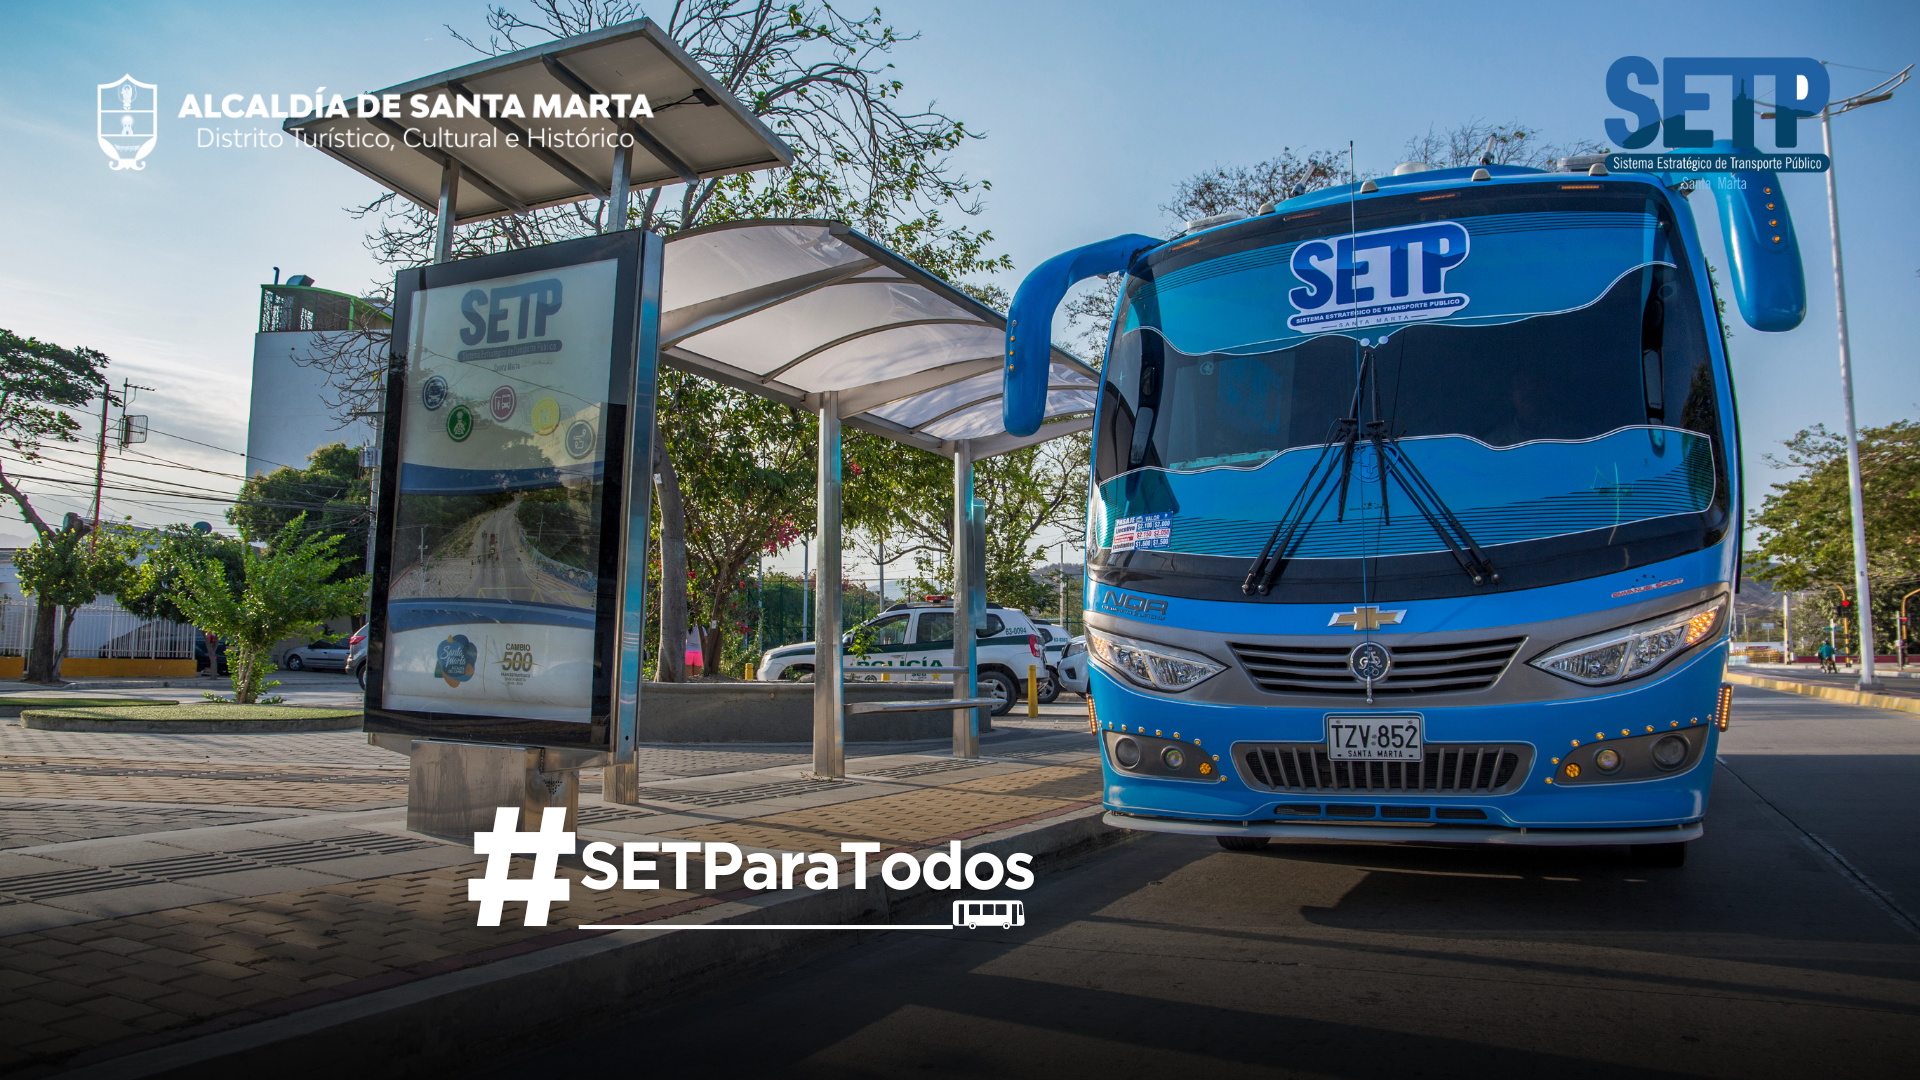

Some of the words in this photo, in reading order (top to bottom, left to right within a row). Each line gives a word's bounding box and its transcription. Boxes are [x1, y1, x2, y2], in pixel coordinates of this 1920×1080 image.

[1290, 223, 1467, 310] SETP
[460, 278, 563, 346] SETP
[1296, 315, 1324, 324] SISTEMA
[1383, 302, 1428, 313] TRANSPORTE
[1429, 298, 1460, 308] PUBLICO
[1338, 319, 1370, 328] SANTA
[1376, 314, 1409, 324] MARTA
[1655, 578, 1683, 589] SPORT
[1103, 591, 1168, 615] NQR
[505, 643, 531, 651] CAMBIO
[501, 651, 533, 672] 500
[1331, 724, 1370, 748] TZV
[1377, 724, 1418, 748] 852
[1347, 750, 1372, 758] SANTA
[1377, 750, 1403, 758] MARTA
